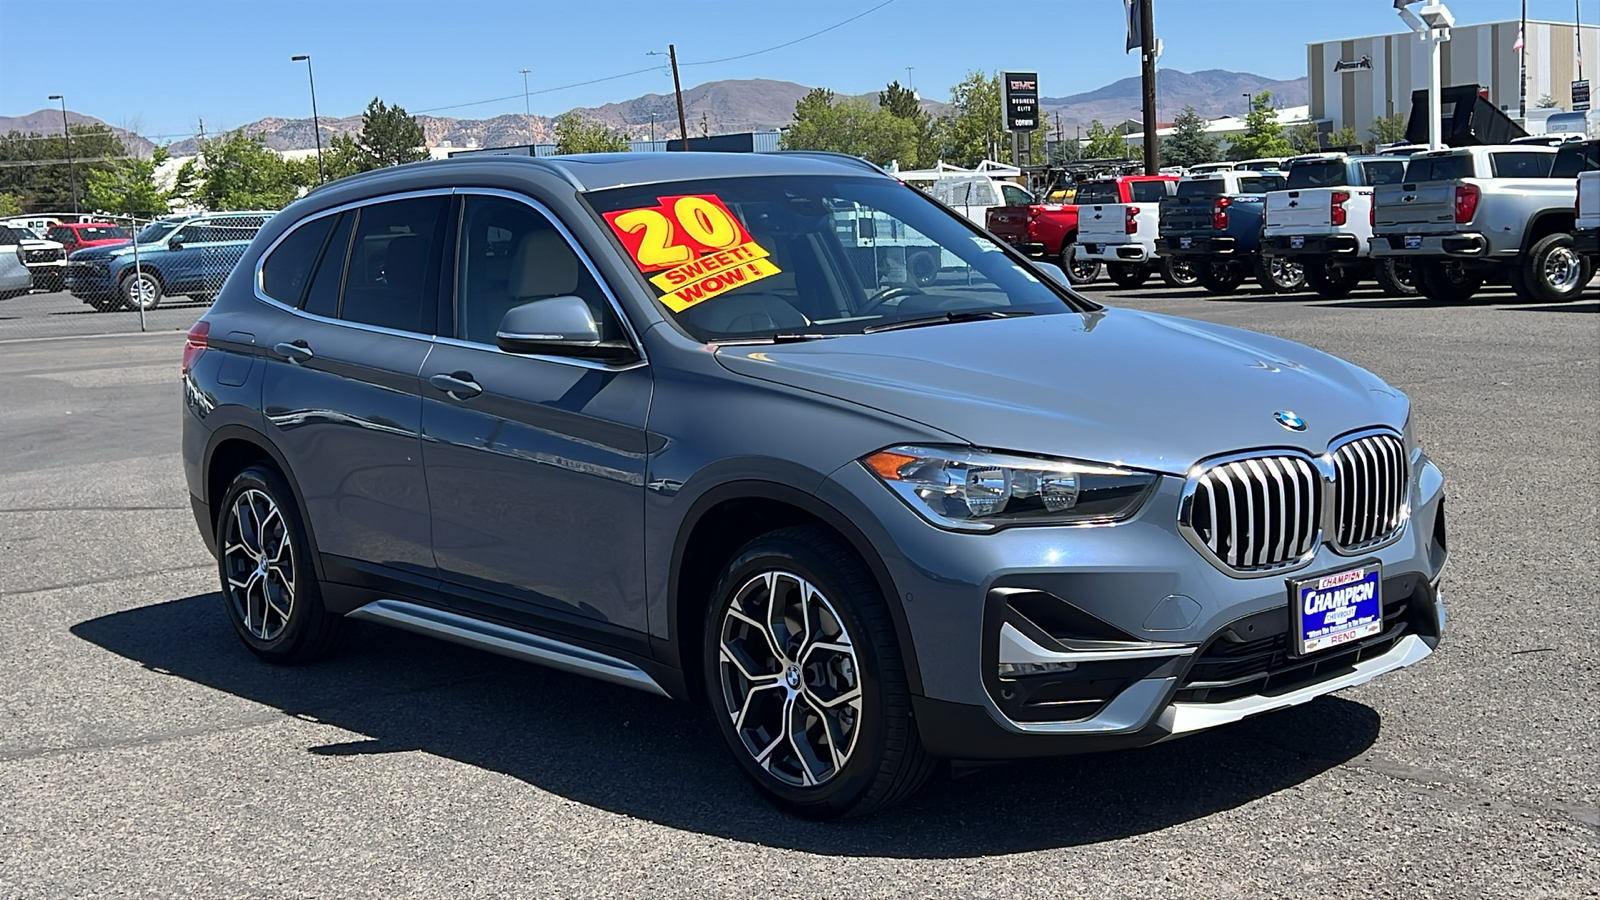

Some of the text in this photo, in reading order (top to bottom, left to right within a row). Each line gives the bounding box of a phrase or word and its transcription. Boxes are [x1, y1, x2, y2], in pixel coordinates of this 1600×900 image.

[1010, 81, 1035, 89] GMC
[614, 197, 741, 267] 20
[665, 246, 754, 286] SWEET!
[1322, 571, 1360, 588] CHAMPION
[1304, 581, 1375, 615] CHAMPION
[1331, 630, 1356, 644] RENO
